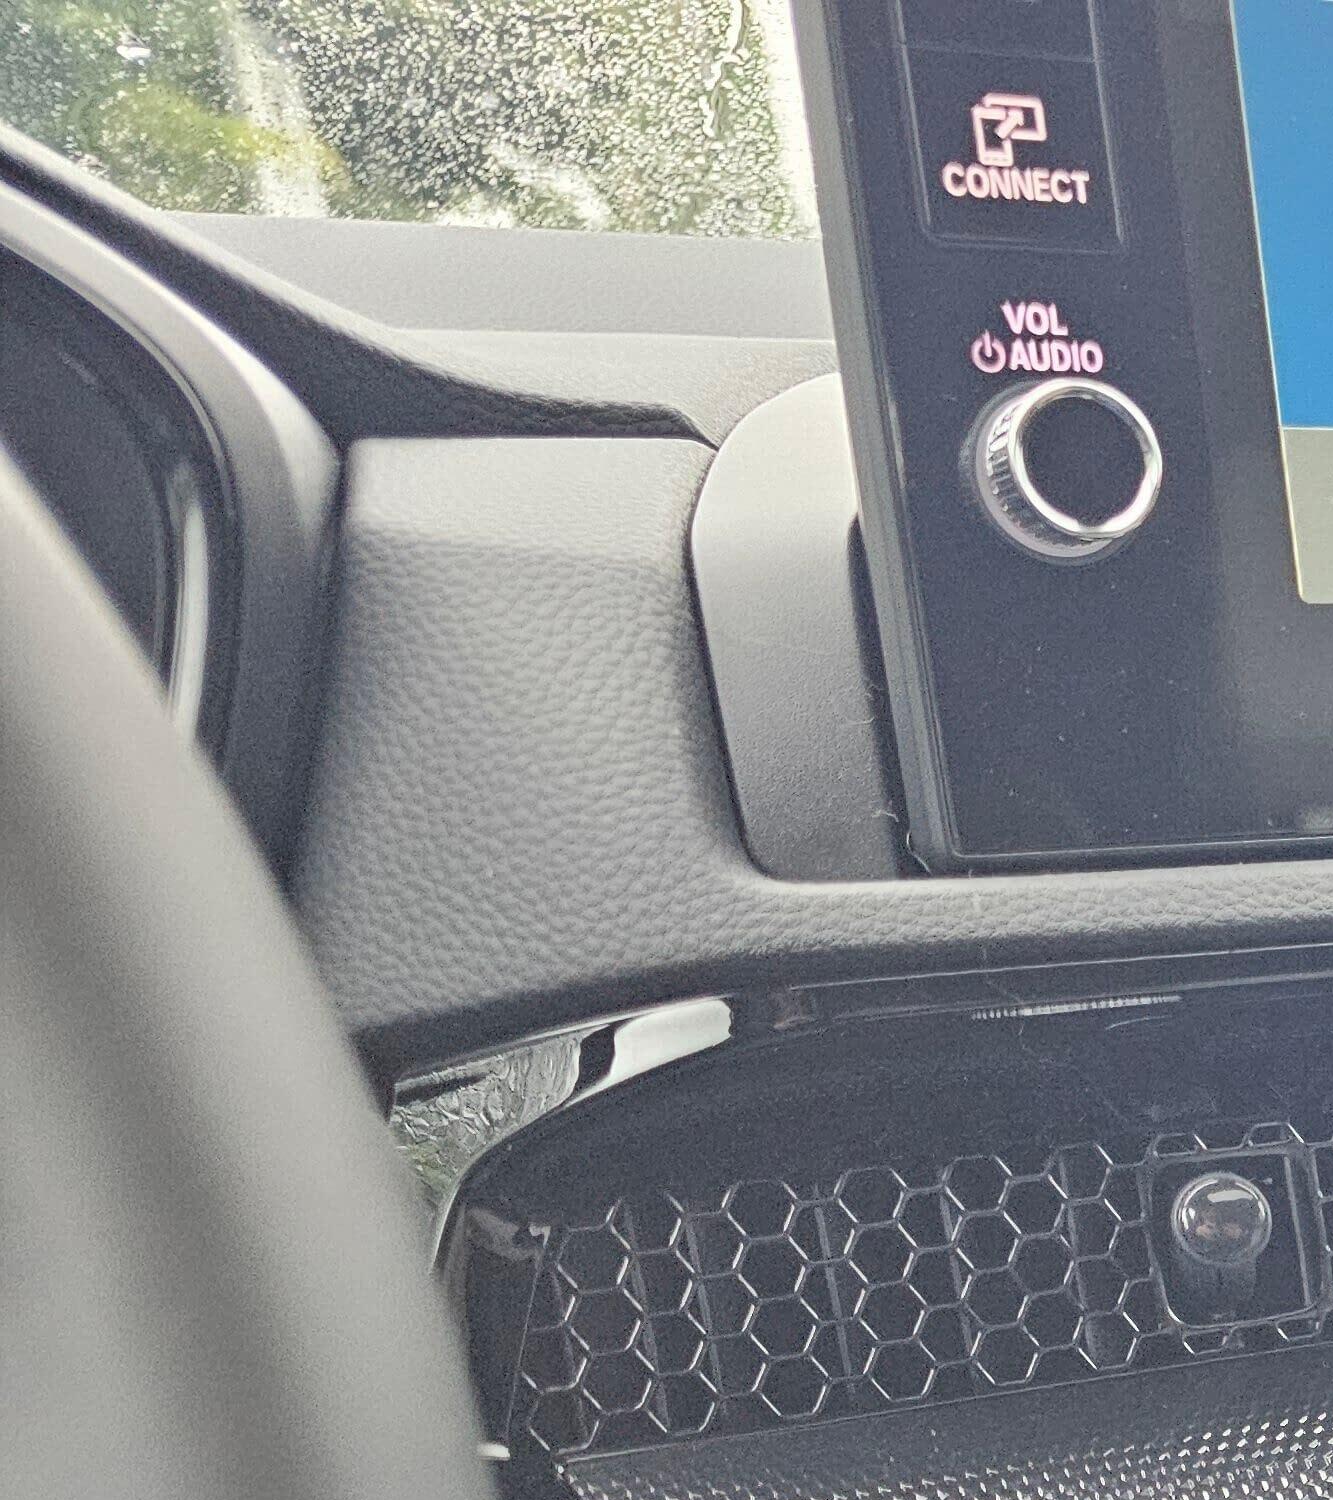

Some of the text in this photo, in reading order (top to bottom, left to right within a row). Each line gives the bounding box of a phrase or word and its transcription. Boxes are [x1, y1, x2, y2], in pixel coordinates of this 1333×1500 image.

[942, 161, 1089, 203] CONNECT
[1001, 301, 1068, 336] VOL
[1008, 338, 1103, 373] AUDIO
